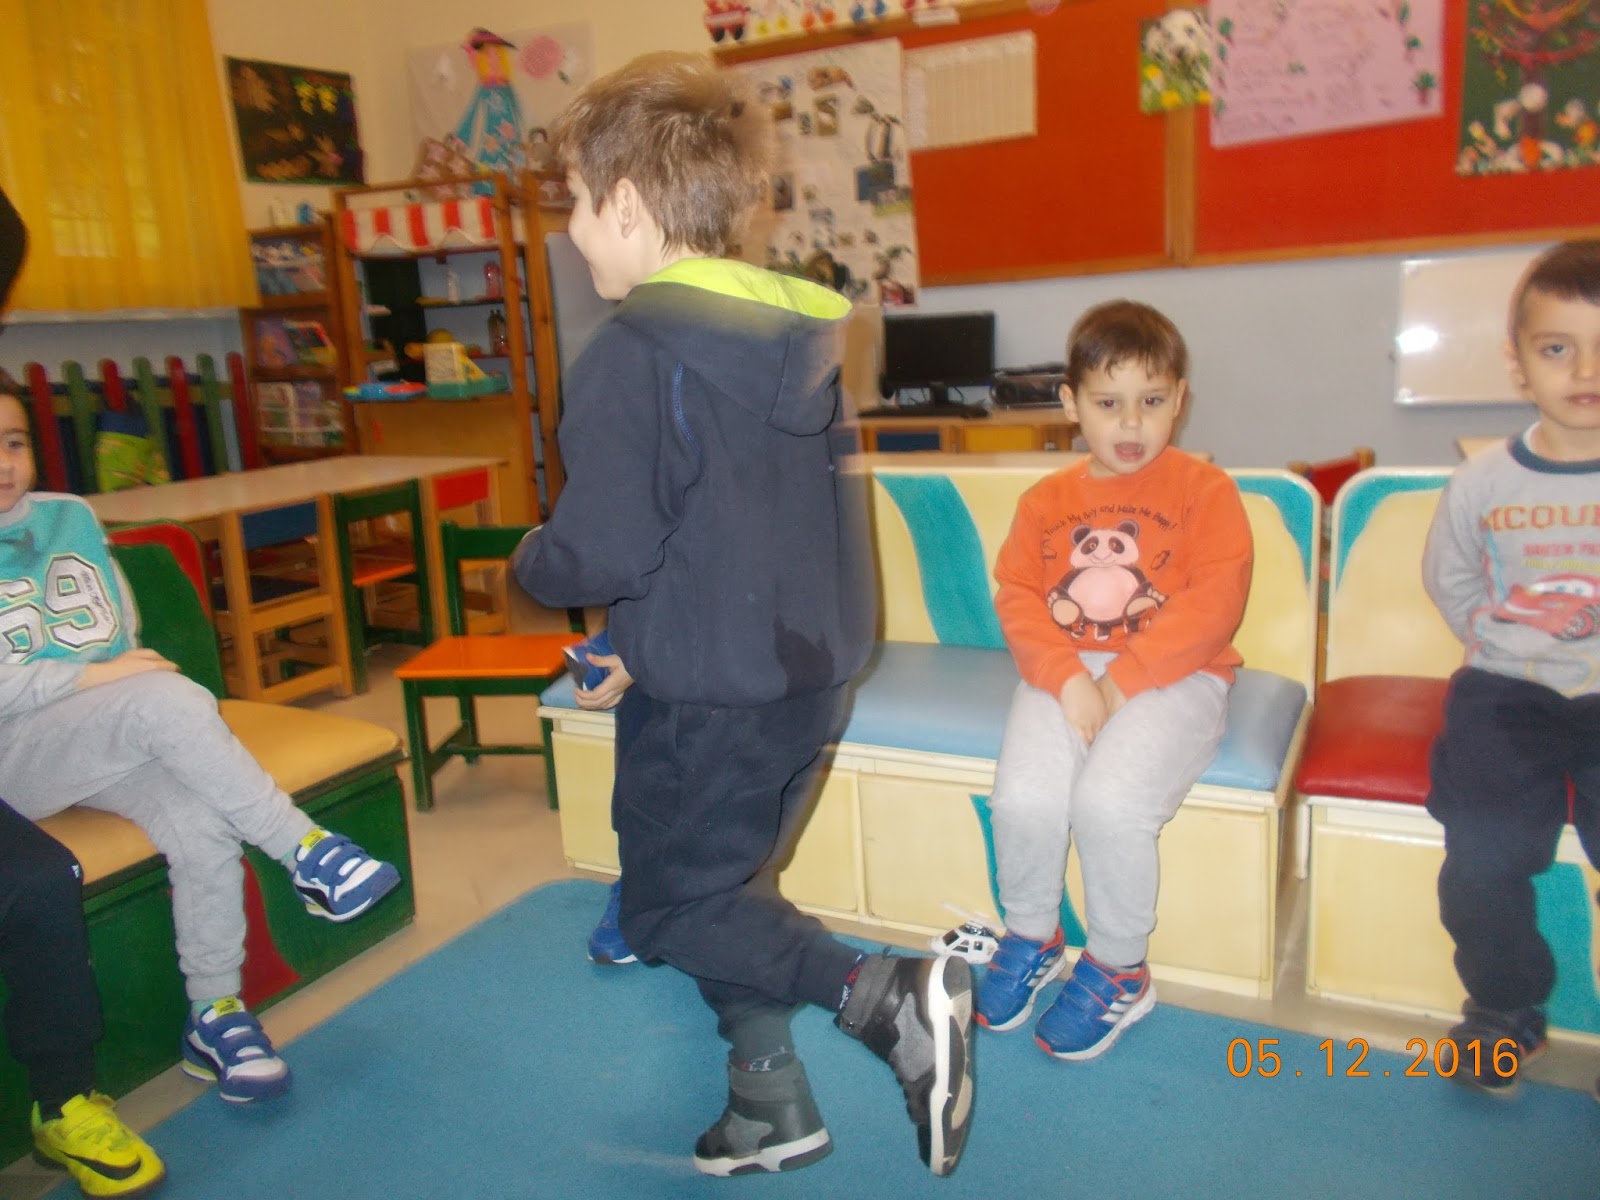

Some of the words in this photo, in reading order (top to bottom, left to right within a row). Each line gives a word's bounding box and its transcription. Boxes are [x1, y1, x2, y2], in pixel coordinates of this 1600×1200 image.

[1066, 513, 1082, 526] My
[1099, 504, 1115, 513] and
[1117, 504, 1137, 515] Make
[1139, 506, 1151, 518] Me
